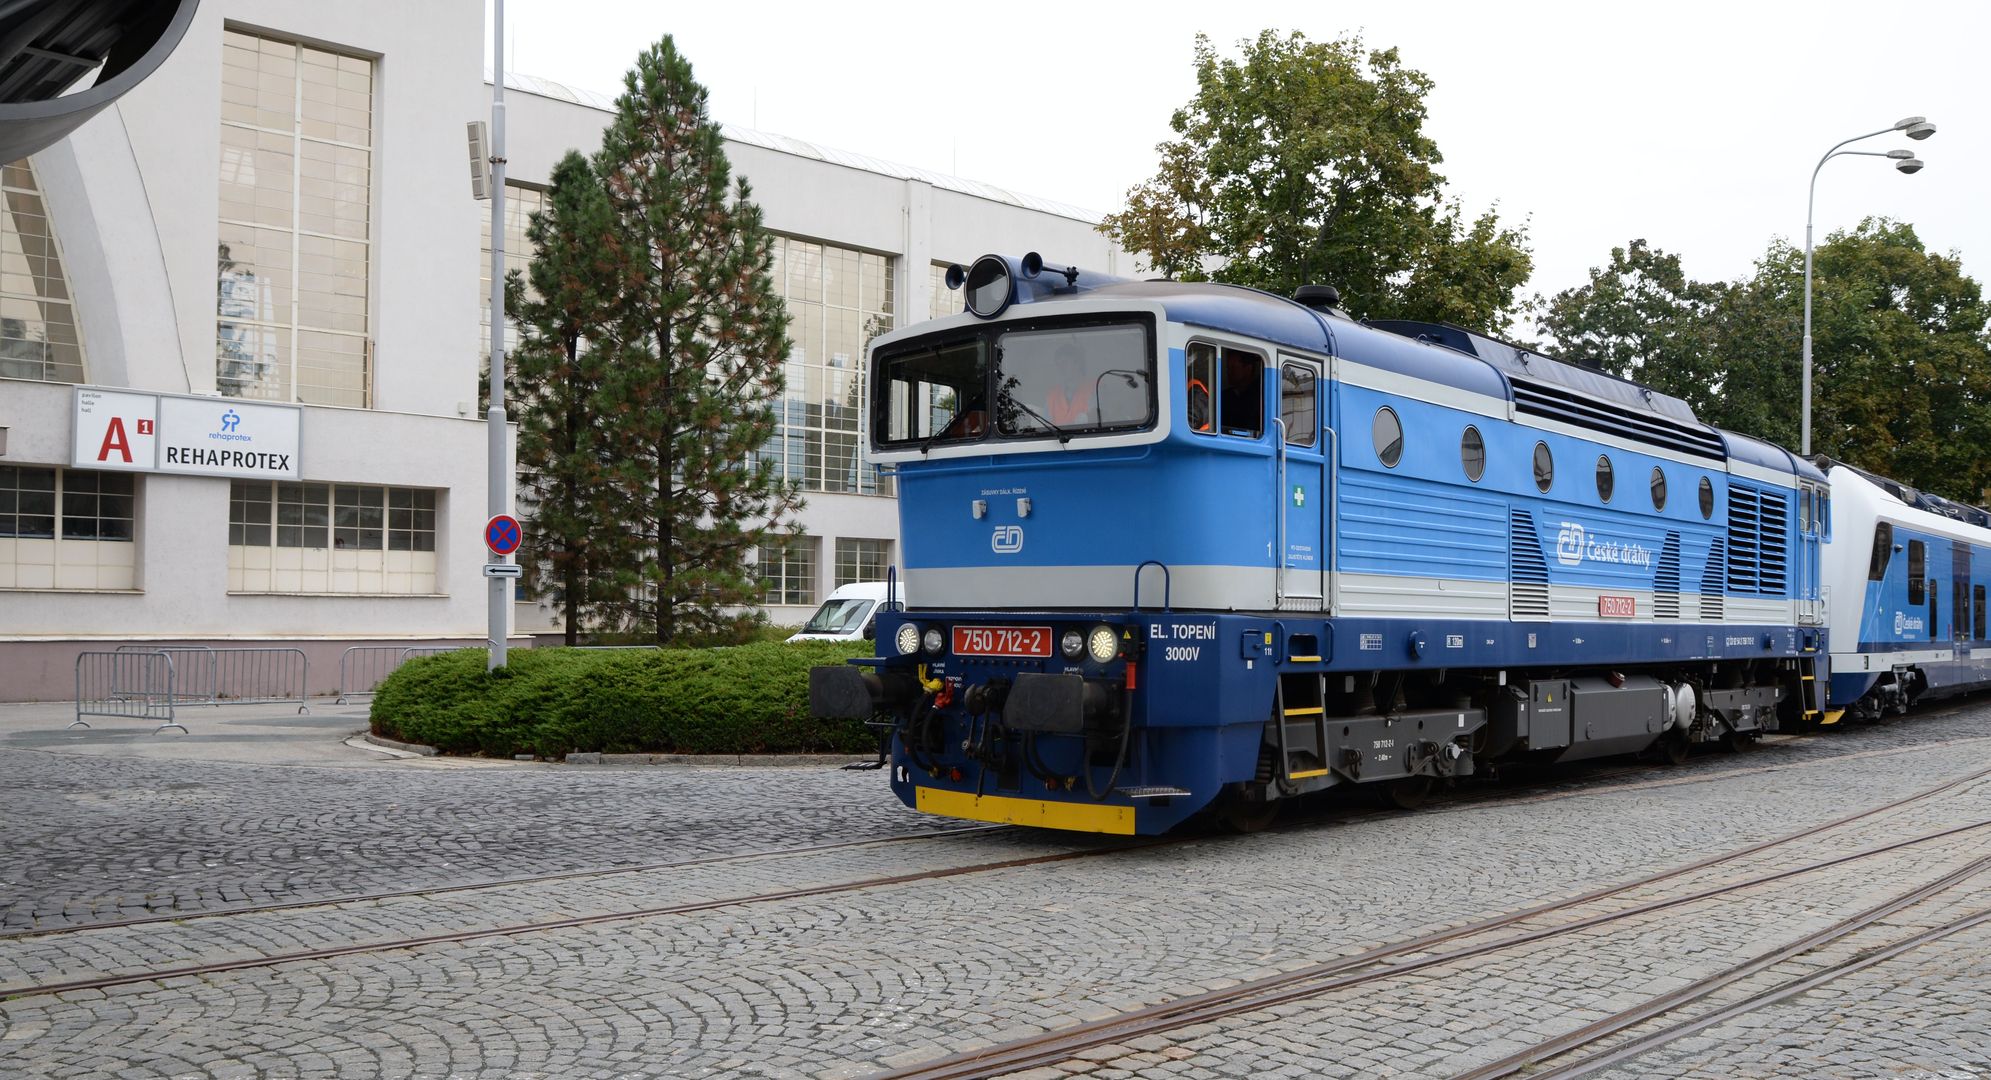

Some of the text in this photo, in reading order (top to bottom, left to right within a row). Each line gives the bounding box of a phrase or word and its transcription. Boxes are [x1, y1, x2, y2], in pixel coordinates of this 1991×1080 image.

[97, 417, 150, 463] A 1
[208, 432, 252, 441] rehaprotex
[167, 446, 290, 471] REHAPROTEX
[1266, 541, 1271, 558] 1
[1587, 533, 1652, 571] České dráhy
[1604, 598, 1632, 614] 750 712-2
[1150, 621, 1216, 640] EL. TOPENÍ
[963, 629, 1041, 653] 750 712-2
[1165, 646, 1200, 661] 3000V
